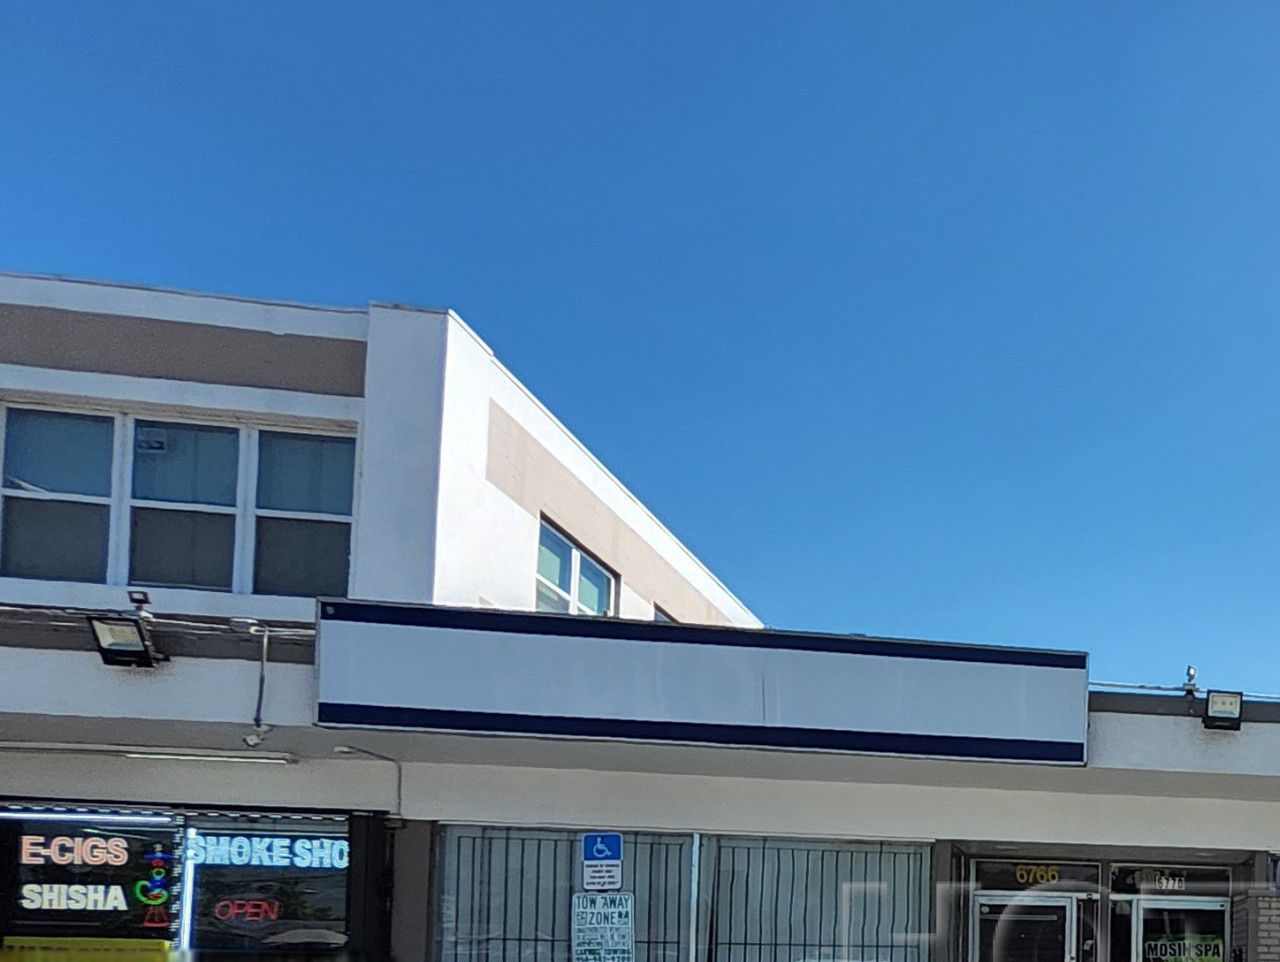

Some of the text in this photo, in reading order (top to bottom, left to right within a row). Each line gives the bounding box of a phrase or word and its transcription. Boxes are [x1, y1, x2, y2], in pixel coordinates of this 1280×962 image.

[20, 835, 129, 866] E-CIGS
[187, 836, 291, 866] SMOKE
[1015, 865, 1060, 884] 6766
[19, 883, 129, 911] SHISHA
[577, 895, 630, 910] TOW AWAY
[214, 900, 279, 922] OPEN
[588, 911, 617, 926] ZONE
[1194, 942, 1221, 958] SPA
